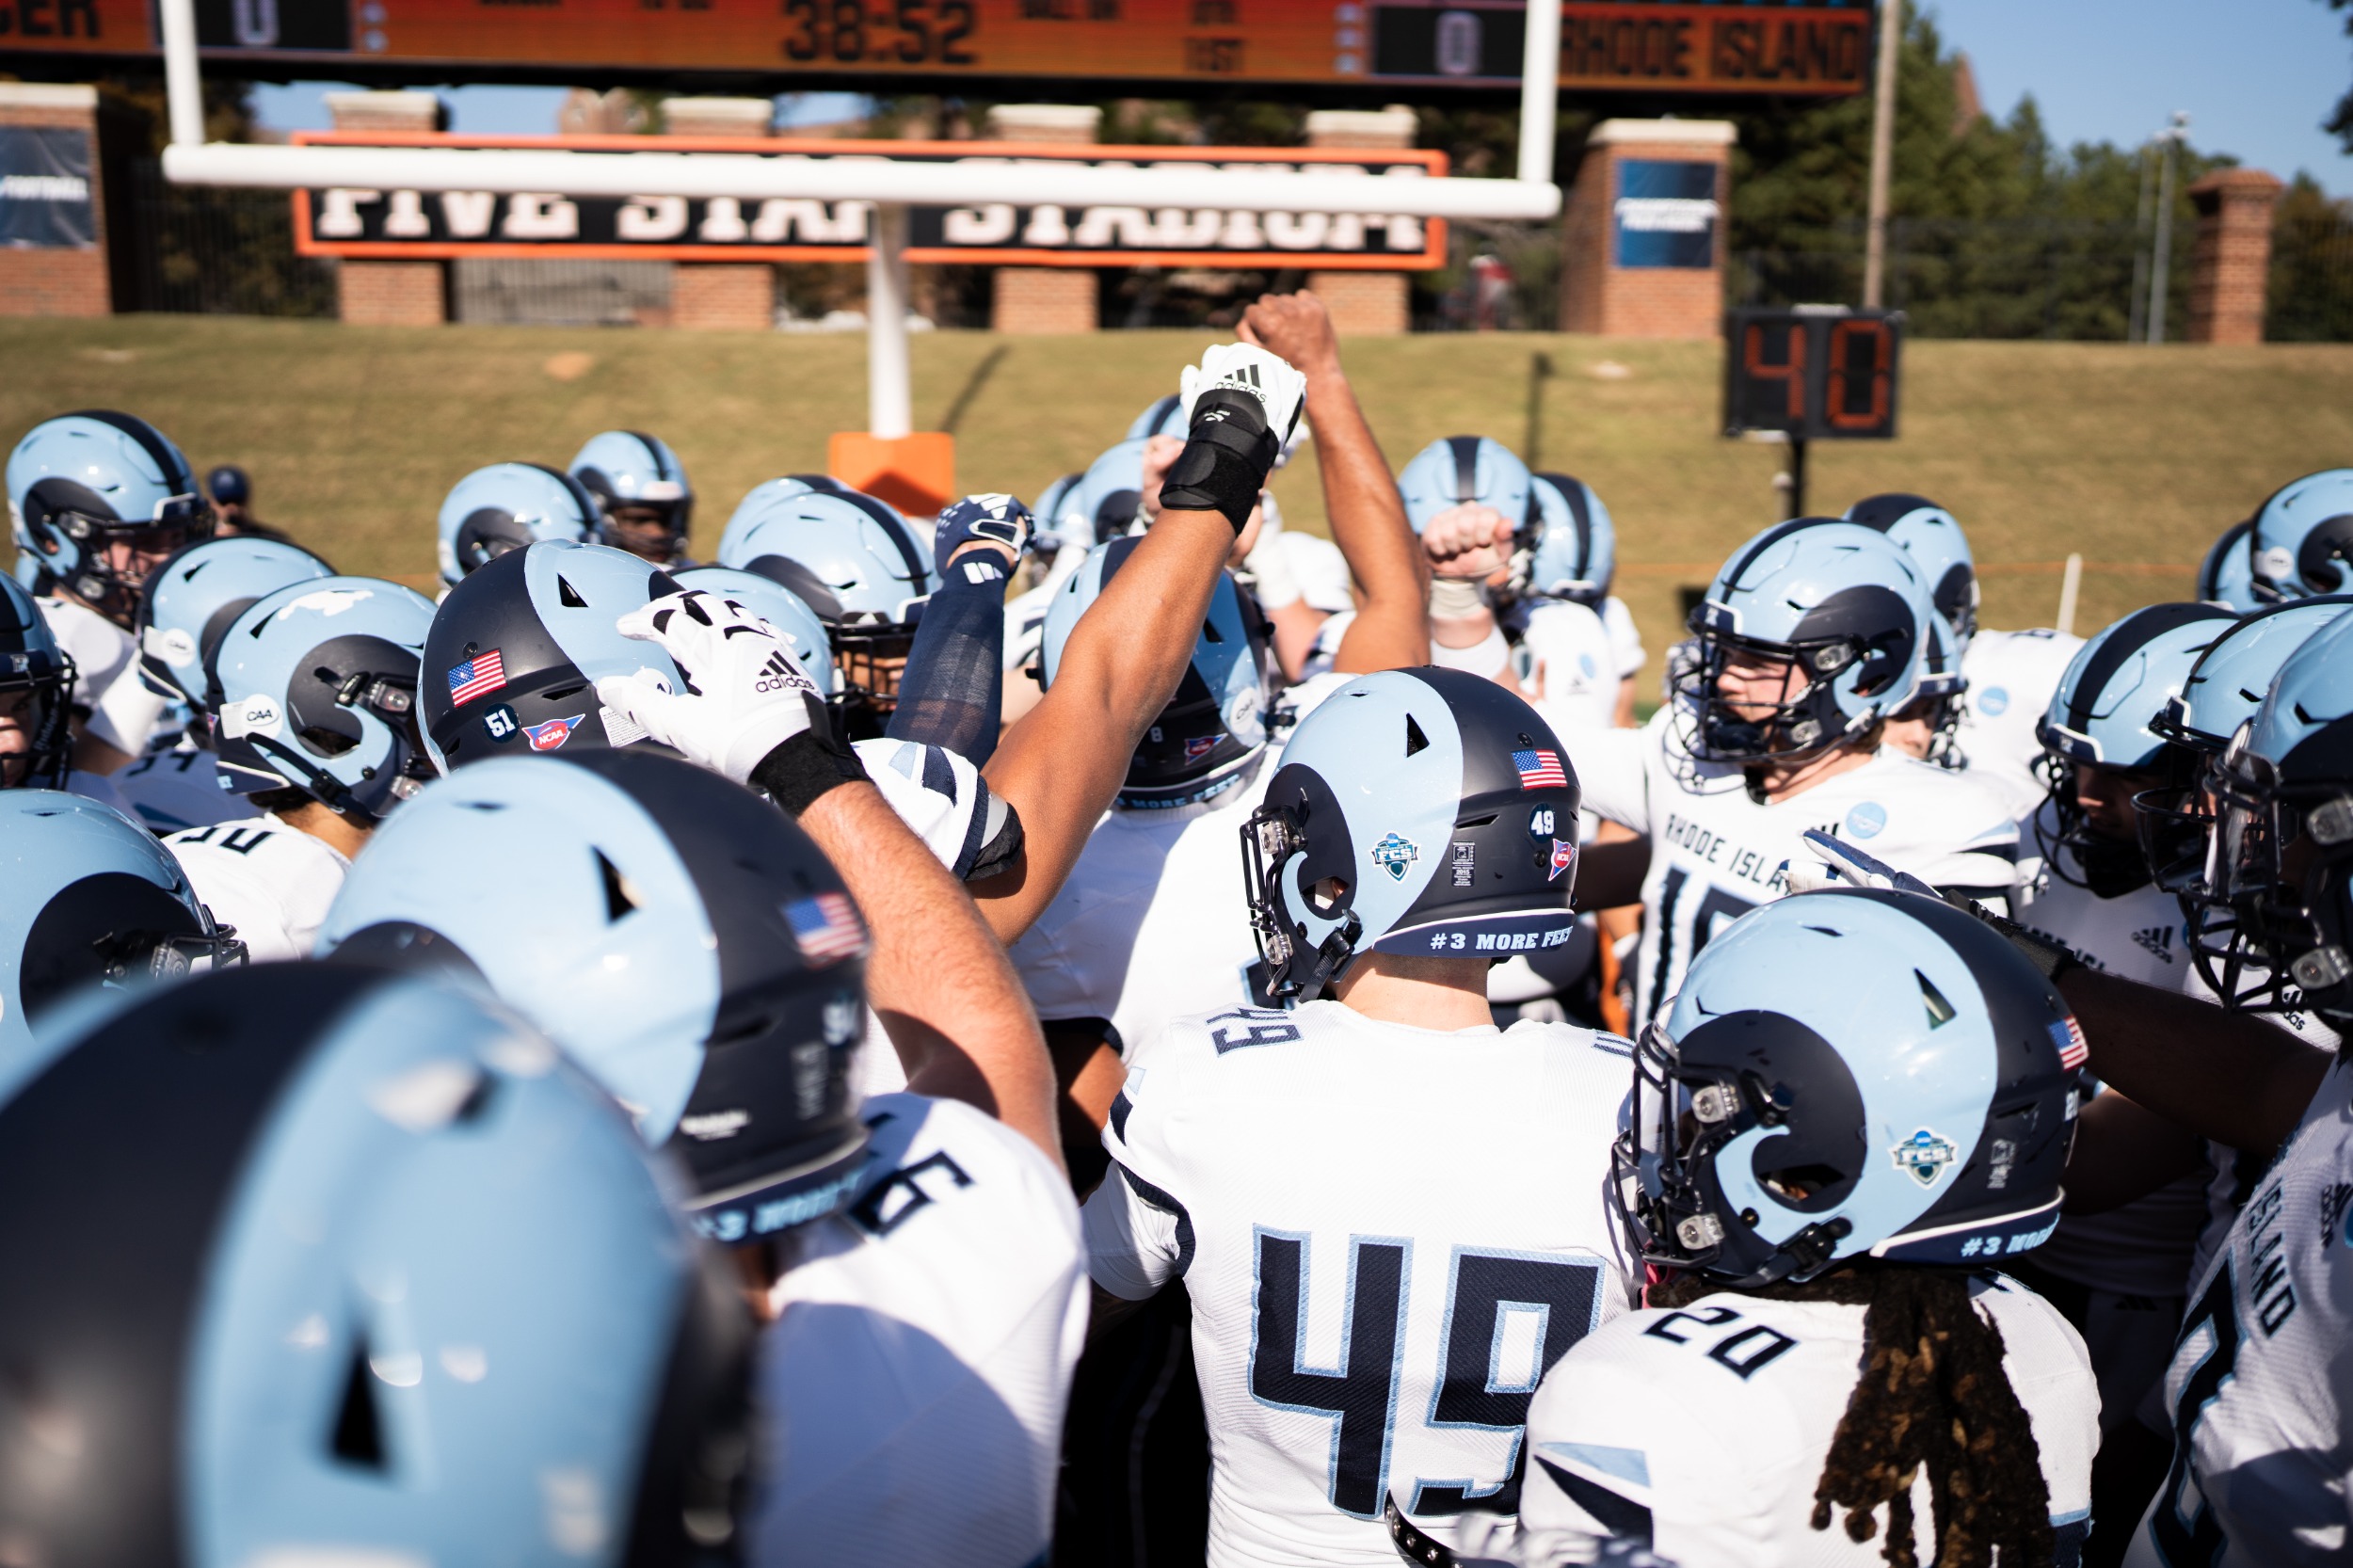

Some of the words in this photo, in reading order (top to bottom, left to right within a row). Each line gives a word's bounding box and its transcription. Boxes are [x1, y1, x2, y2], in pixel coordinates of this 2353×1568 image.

[784, 0, 981, 64] 38:52
[1435, 9, 1484, 75] 0
[1709, 18, 1865, 82] ISLAND
[1743, 318, 1892, 430] 40
[755, 675, 815, 694] adidas
[247, 709, 273, 722] CAA
[485, 708, 517, 738] 51
[537, 728, 565, 745] NCAA
[1530, 809, 1555, 836] 49
[1377, 847, 1413, 861] FCS
[1728, 847, 1793, 896] ISLA
[1475, 932, 1540, 951] MORE
[1900, 1147, 1947, 1162] FCS
[2248, 1176, 2297, 1338] ISLAND
[1641, 1306, 1802, 1383] 20
[1247, 1222, 1608, 1521] 49
